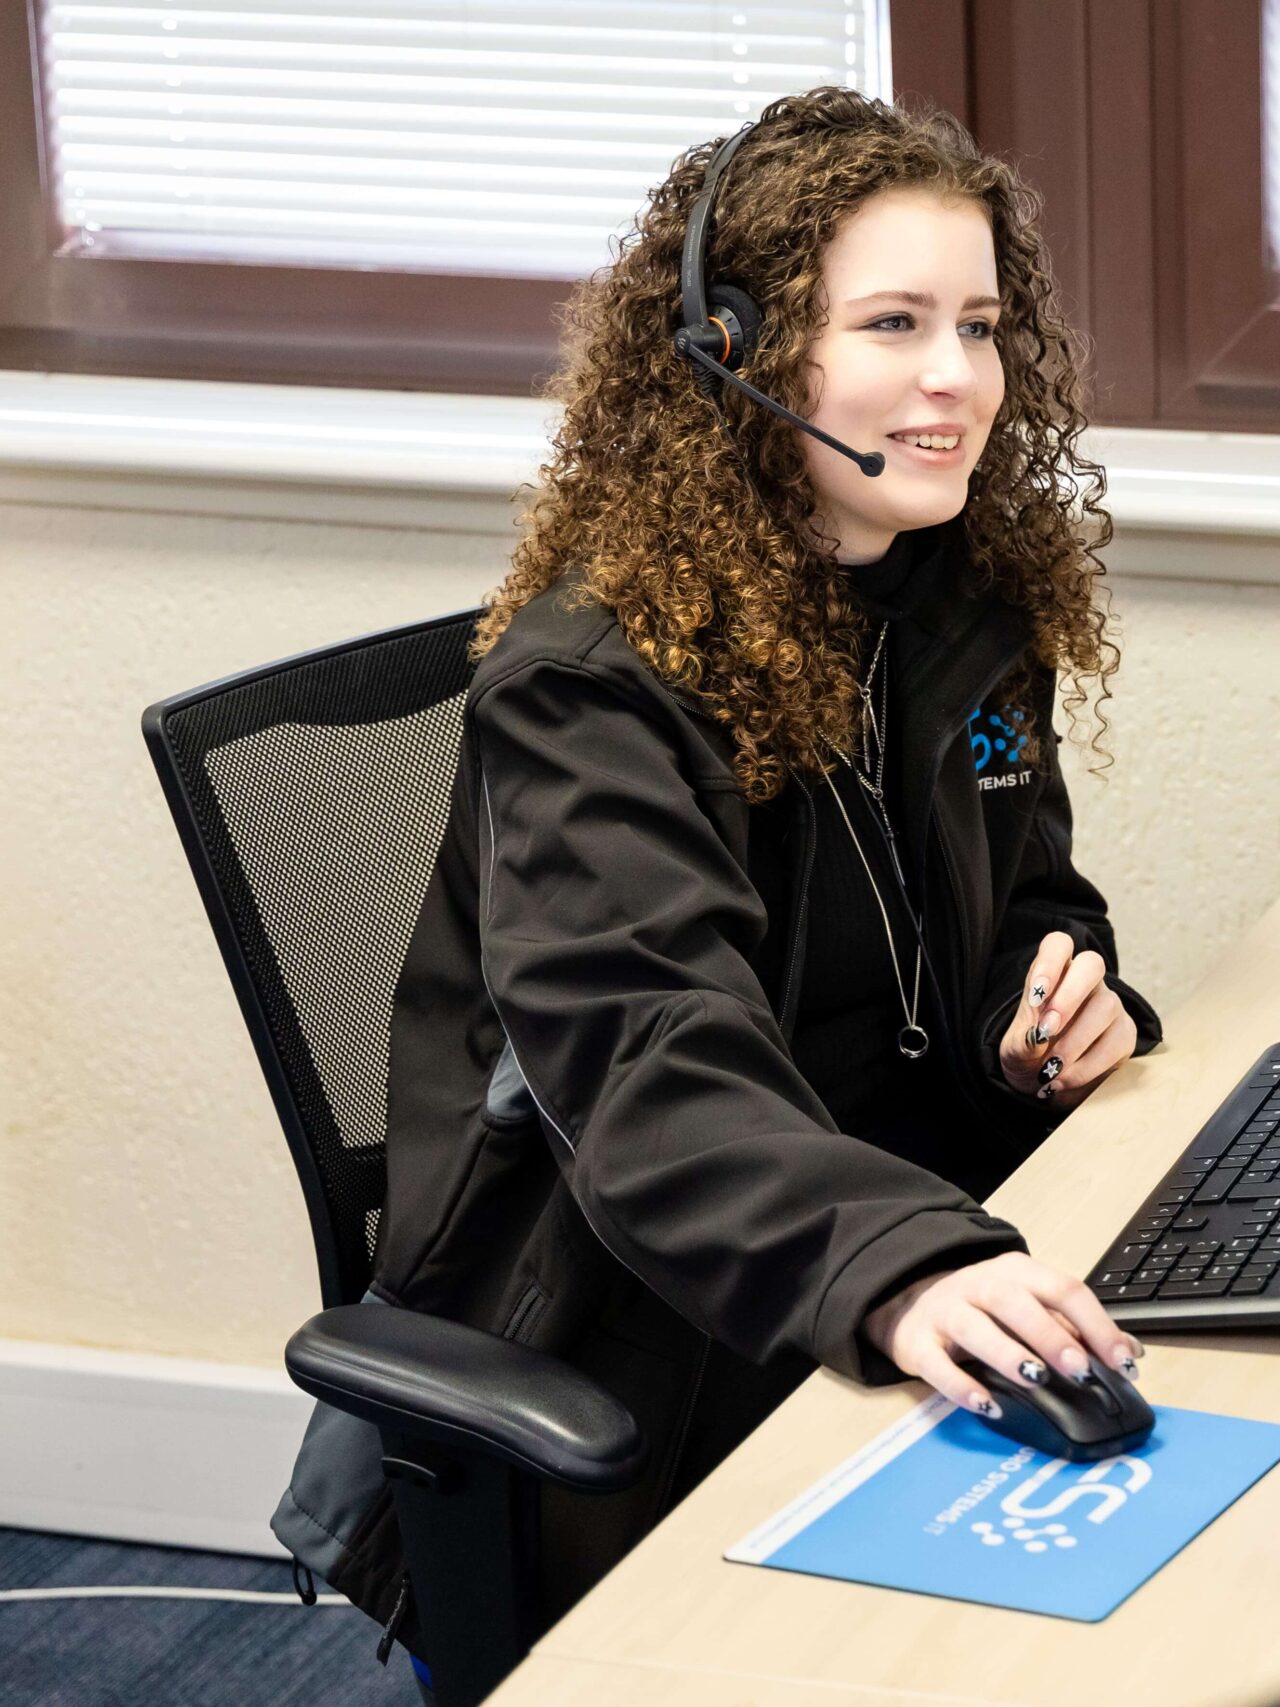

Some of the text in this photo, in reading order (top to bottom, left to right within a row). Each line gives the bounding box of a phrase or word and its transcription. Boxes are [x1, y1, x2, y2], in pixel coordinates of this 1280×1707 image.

[978, 771, 1032, 791] TEMS IT
[1000, 1446, 1036, 1472] URO
